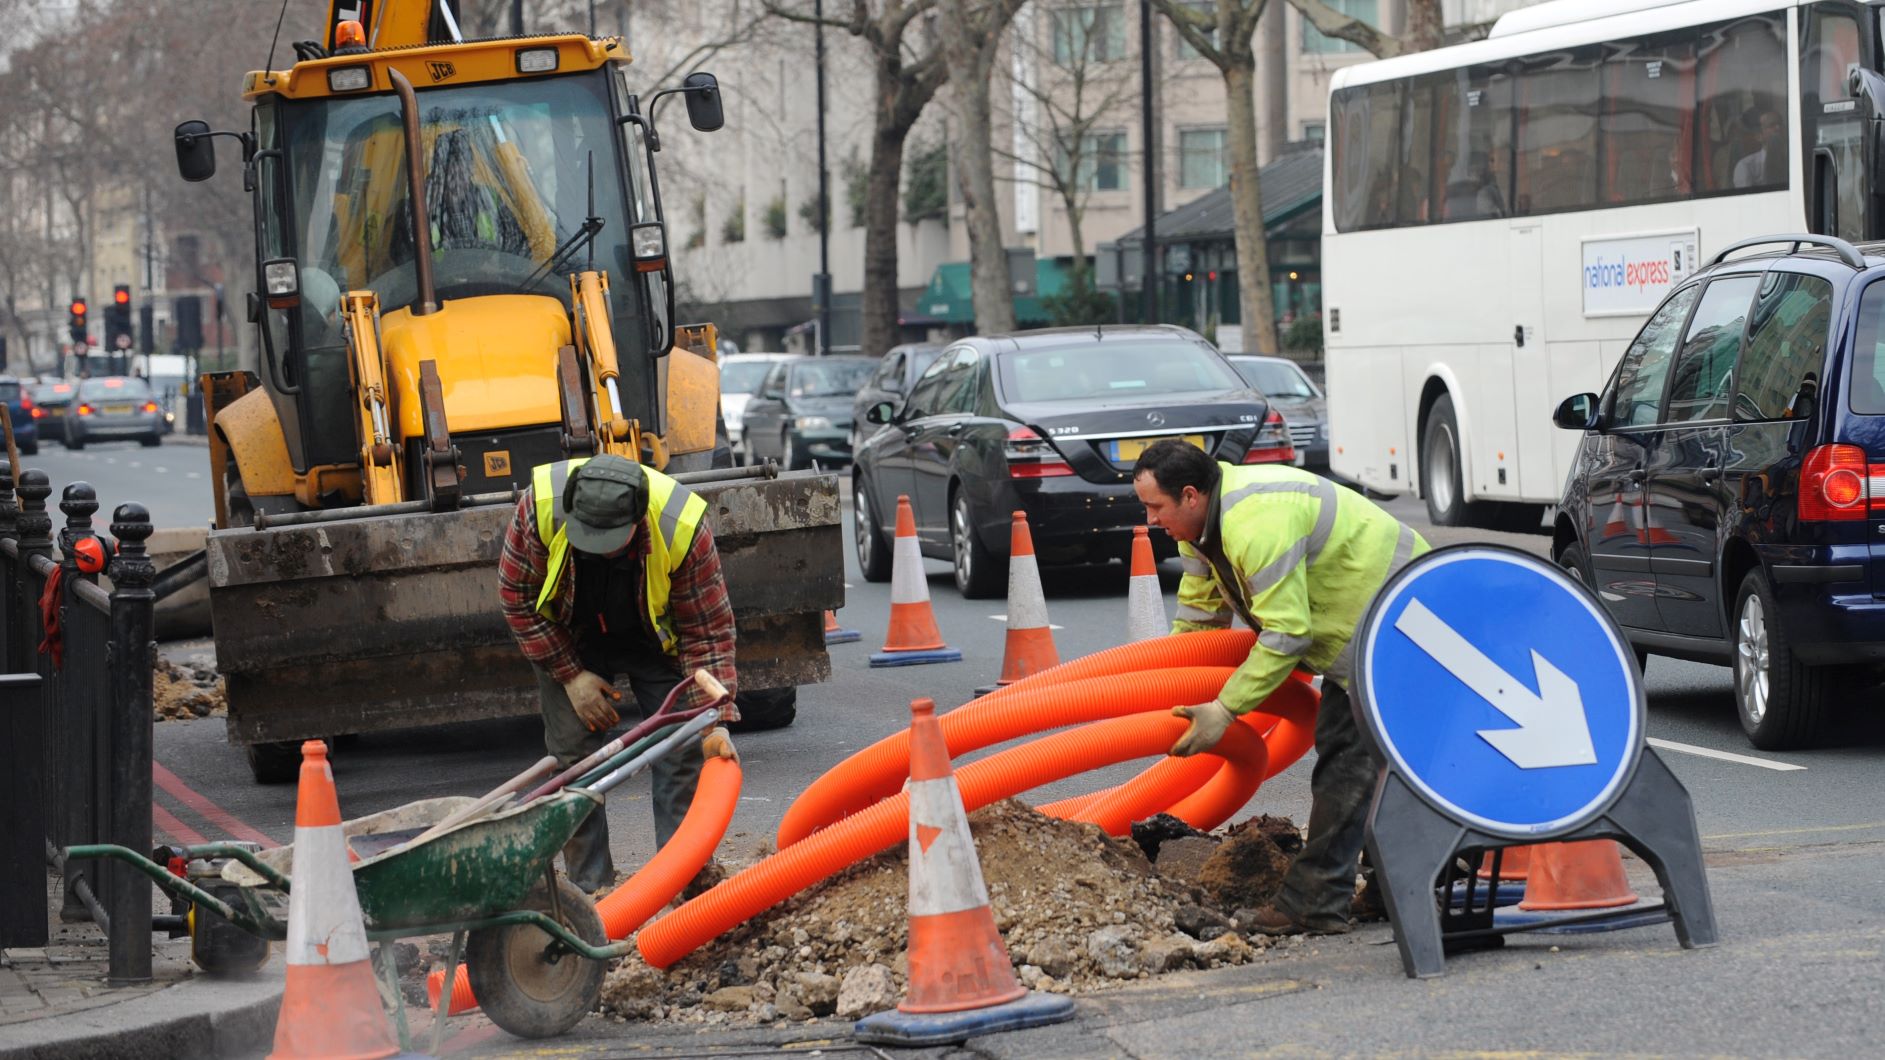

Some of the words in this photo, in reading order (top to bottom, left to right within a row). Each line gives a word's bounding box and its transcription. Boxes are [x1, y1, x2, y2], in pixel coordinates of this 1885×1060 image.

[429, 62, 455, 81] JCB
[1584, 254, 1625, 288] national
[1626, 259, 1669, 294] express
